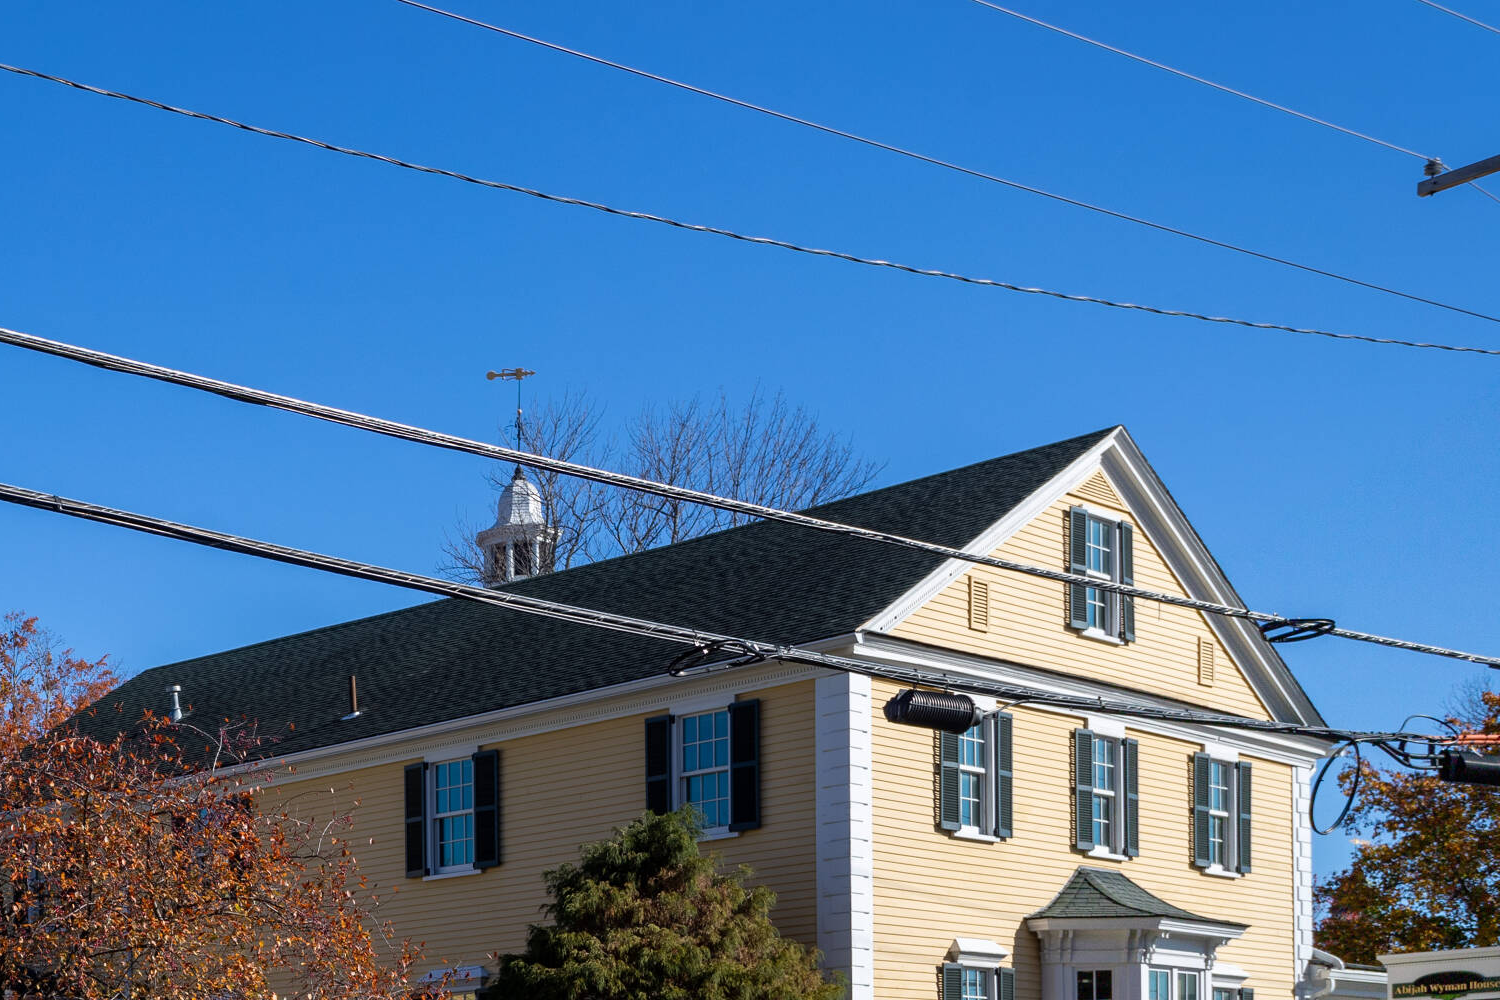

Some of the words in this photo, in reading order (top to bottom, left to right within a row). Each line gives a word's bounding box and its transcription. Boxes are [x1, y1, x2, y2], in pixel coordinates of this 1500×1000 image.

[1395, 984, 1427, 995] Abijah
[1429, 983, 1467, 993] Wyman
[1469, 981, 1500, 990] House
